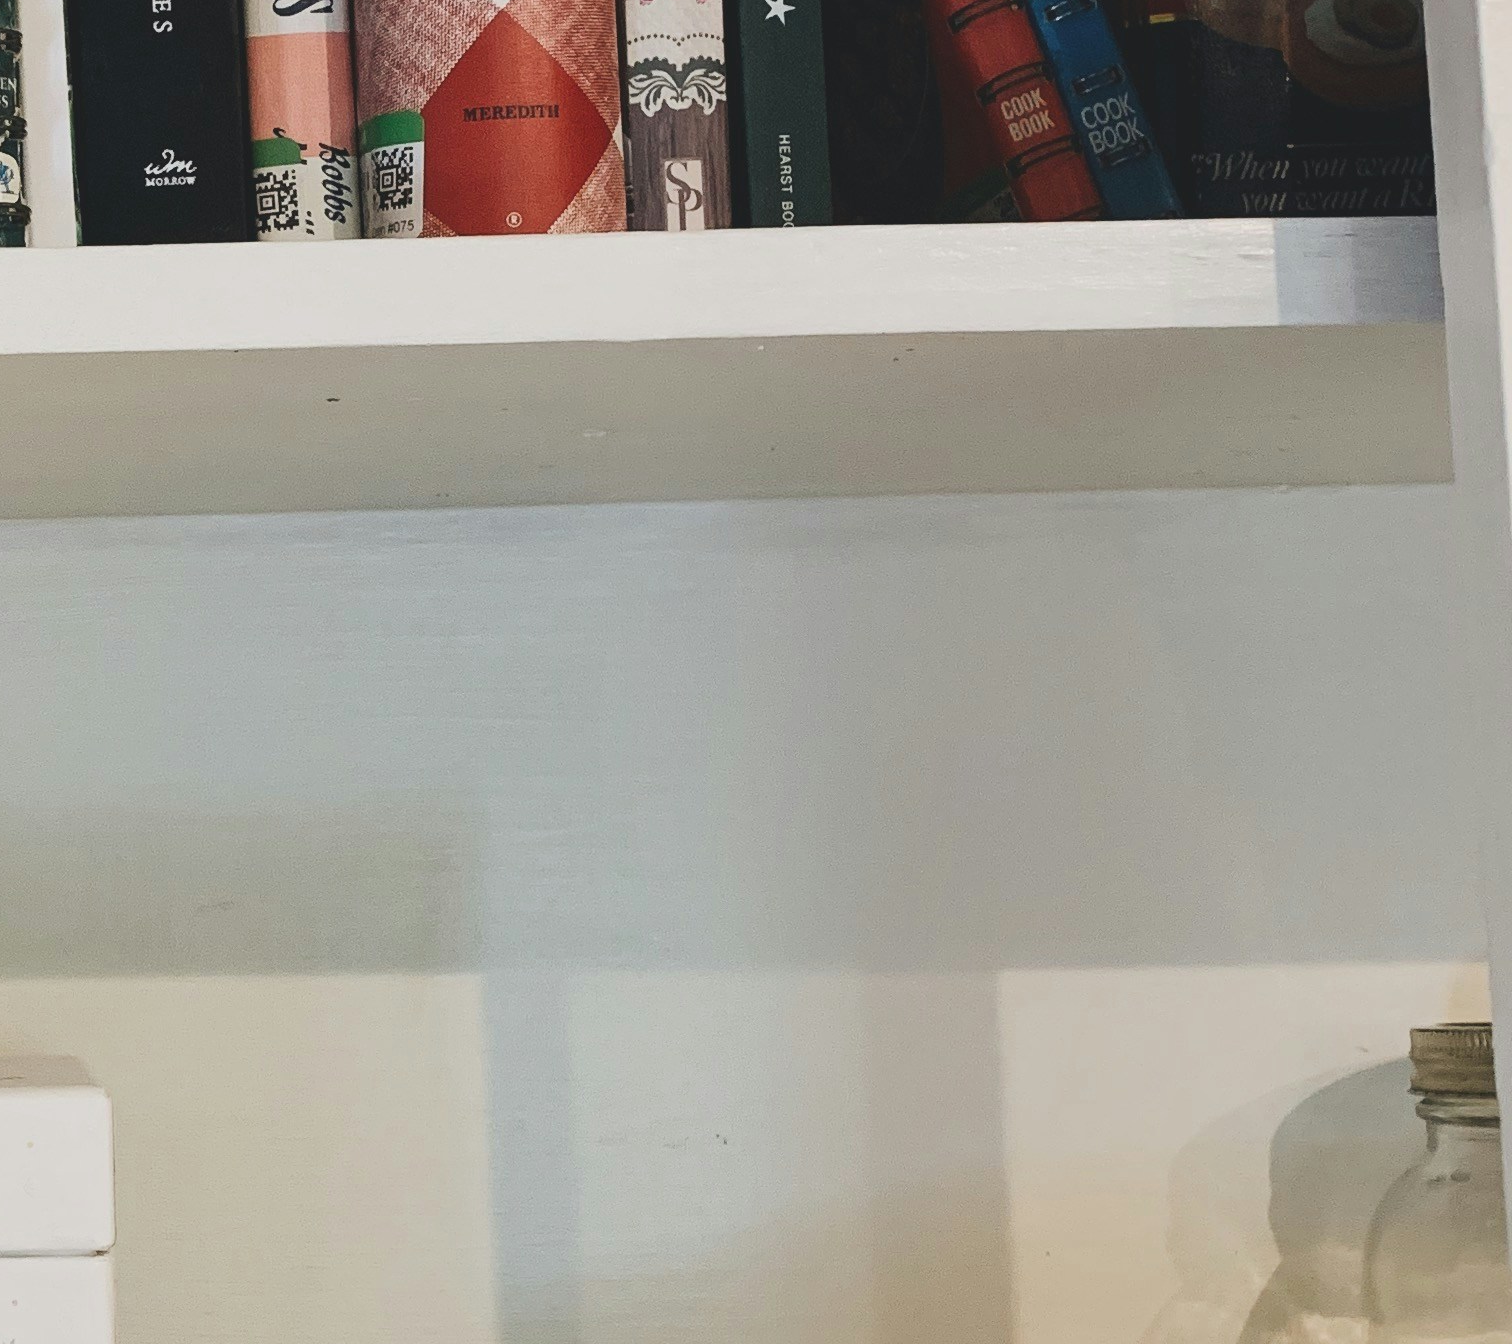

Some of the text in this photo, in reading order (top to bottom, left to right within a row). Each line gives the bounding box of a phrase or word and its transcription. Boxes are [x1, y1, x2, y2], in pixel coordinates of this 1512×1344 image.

[462, 104, 561, 122] MEREDITH
[999, 87, 1048, 121] COOK
[1080, 93, 1137, 130] COOK
[1008, 110, 1056, 143] BOOK
[1088, 117, 1146, 156] BOOK
[777, 134, 795, 192] HEARST
[145, 175, 197, 187] MORROW
[317, 141, 354, 226] Bobbs
[387, 219, 416, 235] #075
